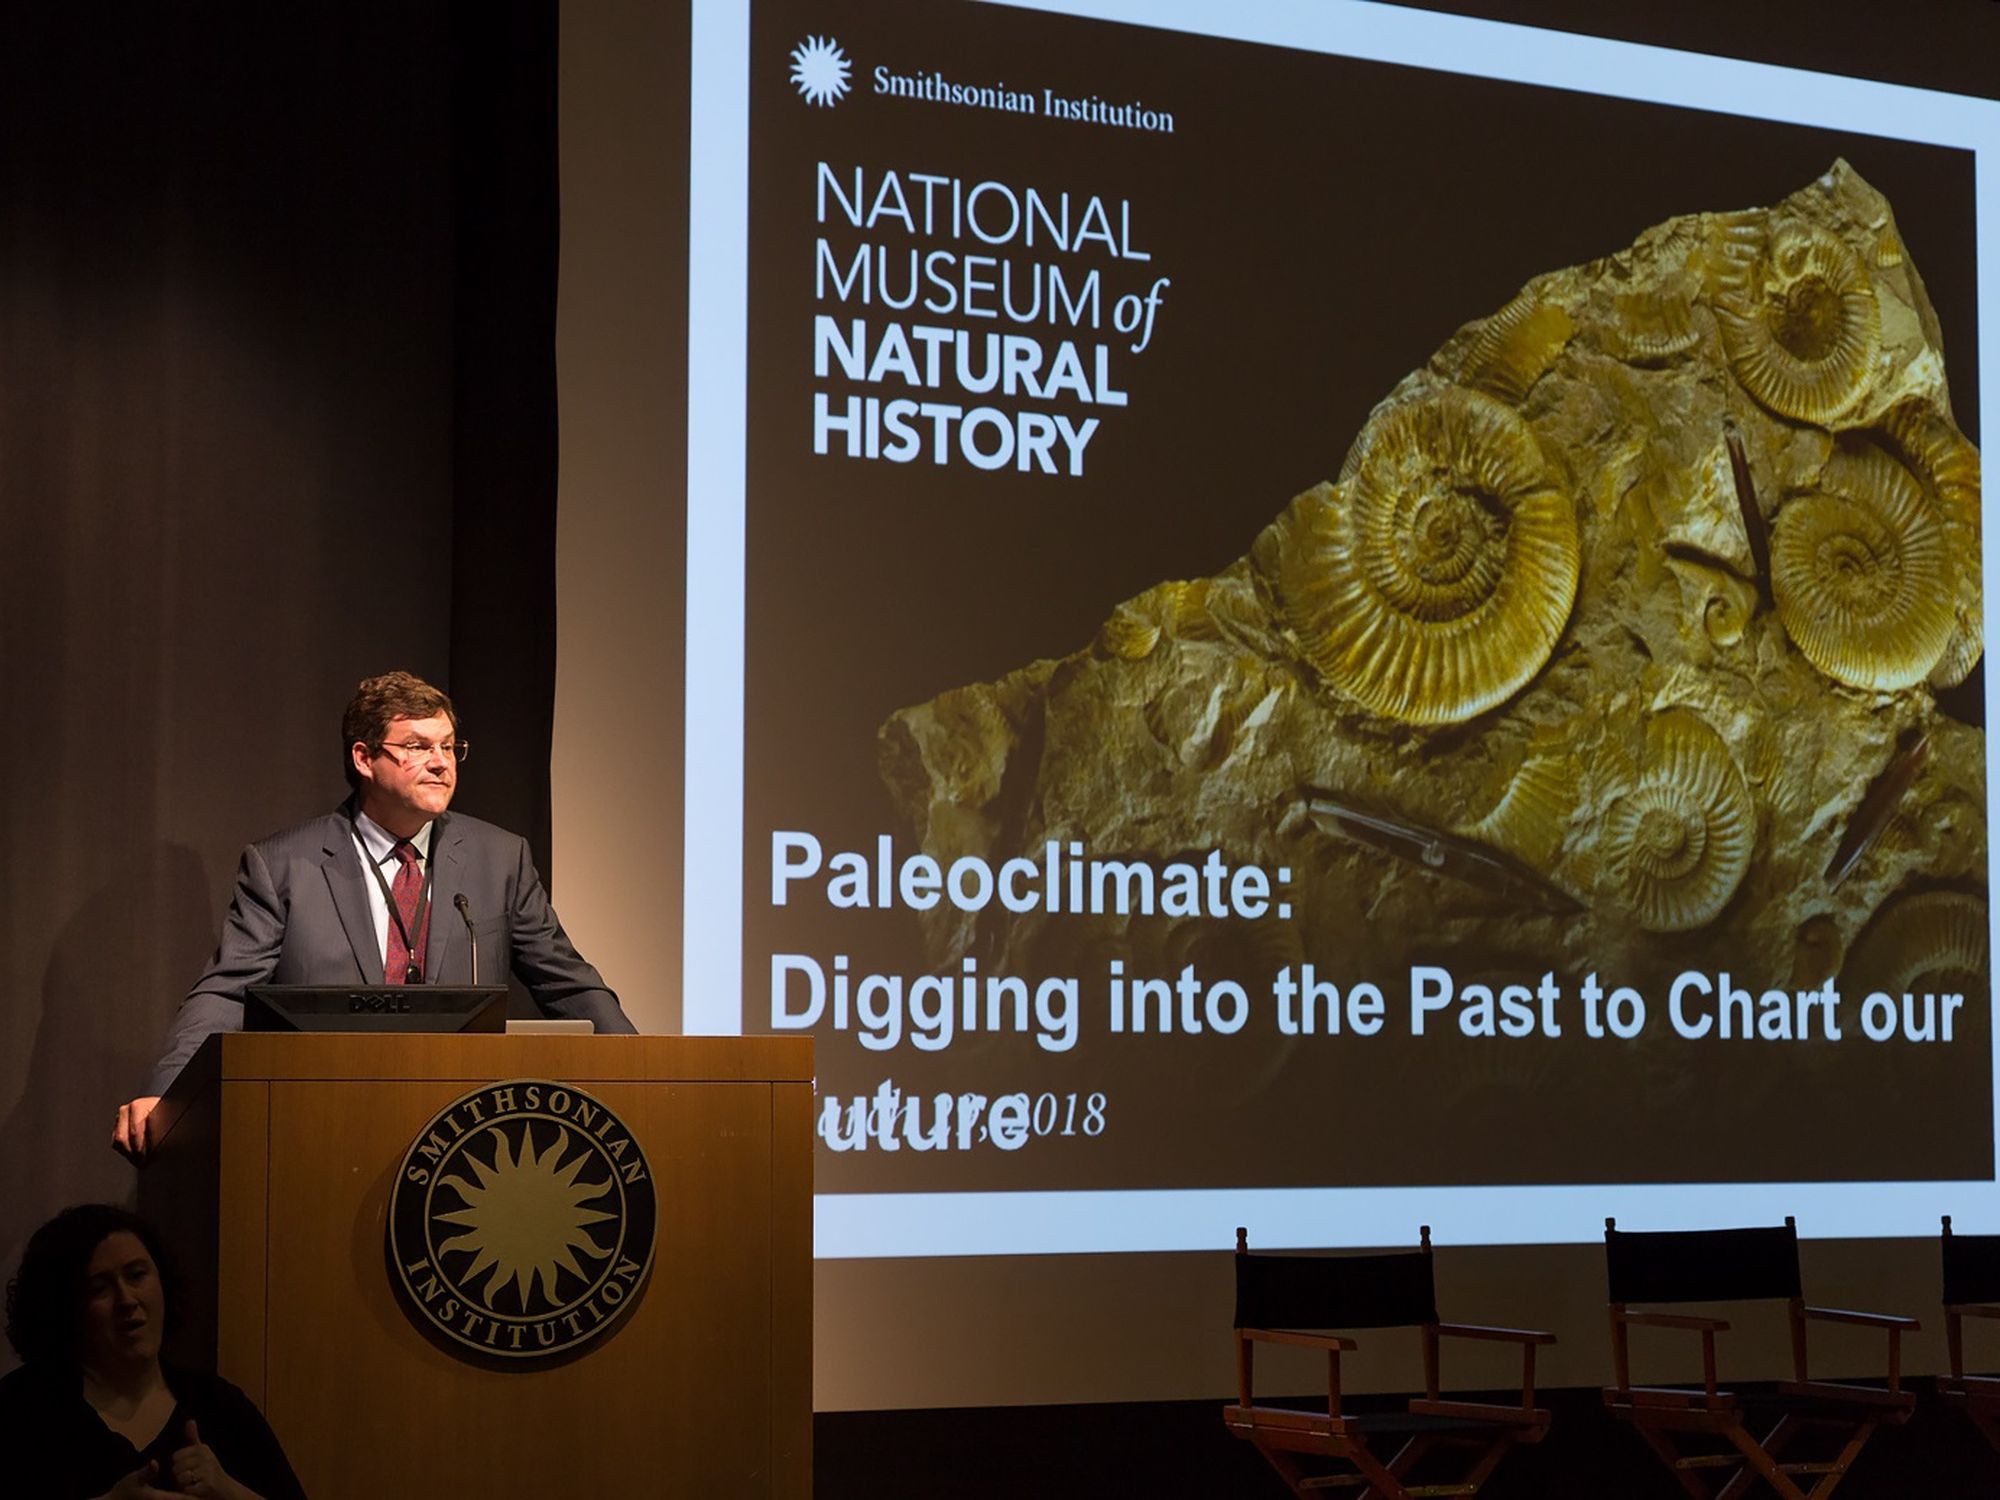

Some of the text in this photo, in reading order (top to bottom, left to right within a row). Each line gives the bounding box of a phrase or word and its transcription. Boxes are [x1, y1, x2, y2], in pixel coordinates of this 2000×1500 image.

[873, 65, 1175, 133] Smithsonian Institution
[817, 161, 1151, 261] NATIONAL
[816, 237, 1171, 354] MUSEUM of
[814, 314, 1128, 407] NATURAL
[813, 392, 1100, 477] HISTORY
[771, 830, 1292, 920] Paleoclimate:
[349, 994, 410, 1013] DELL
[770, 953, 1964, 1052] Digging into the Past to Chart our
[407, 1086, 647, 1185] SMITHSONIAN
[813, 1076, 1031, 1152] uture
[407, 1254, 641, 1348] INSTITUTION
